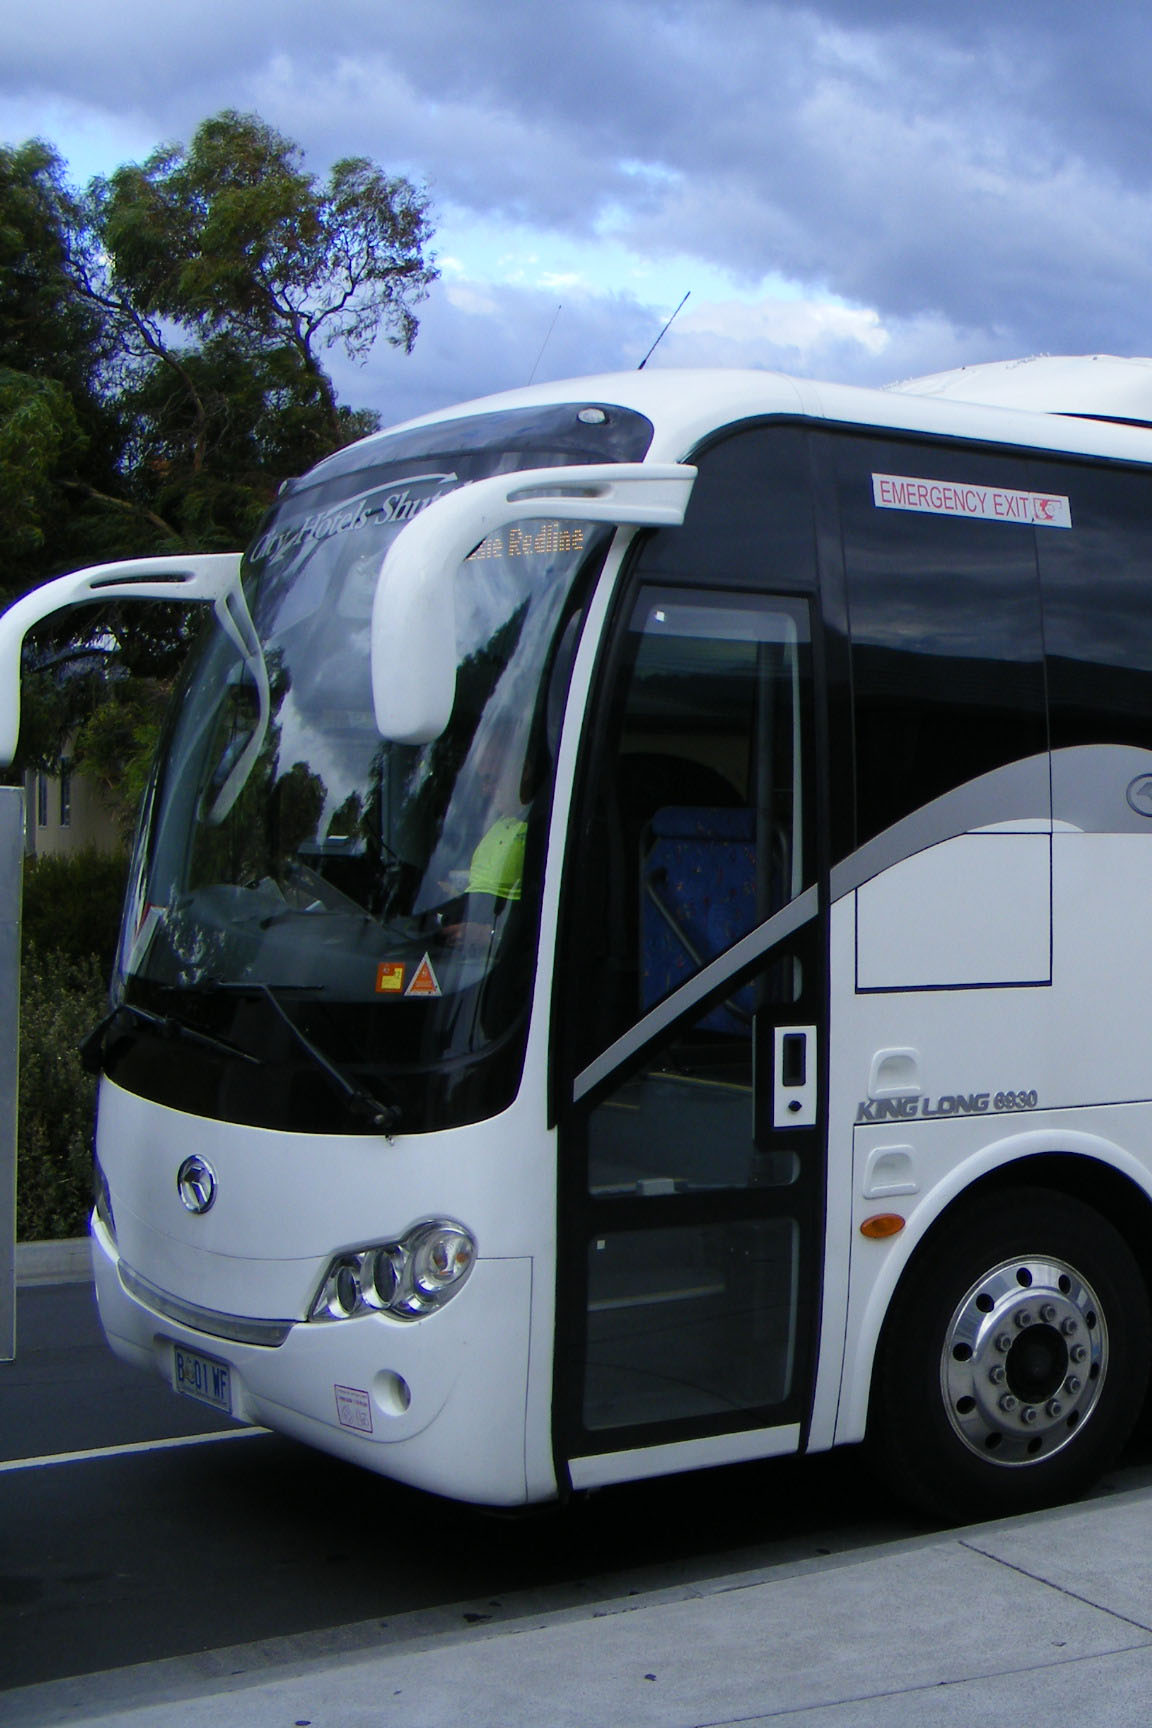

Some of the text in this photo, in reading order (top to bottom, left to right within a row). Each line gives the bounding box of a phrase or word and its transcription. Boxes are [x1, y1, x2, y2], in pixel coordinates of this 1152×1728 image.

[879, 480, 1029, 518] EMERGENCY EXIT
[295, 499, 370, 547] Hotels
[857, 1098, 919, 1120] KING
[922, 1093, 990, 1116] LONG
